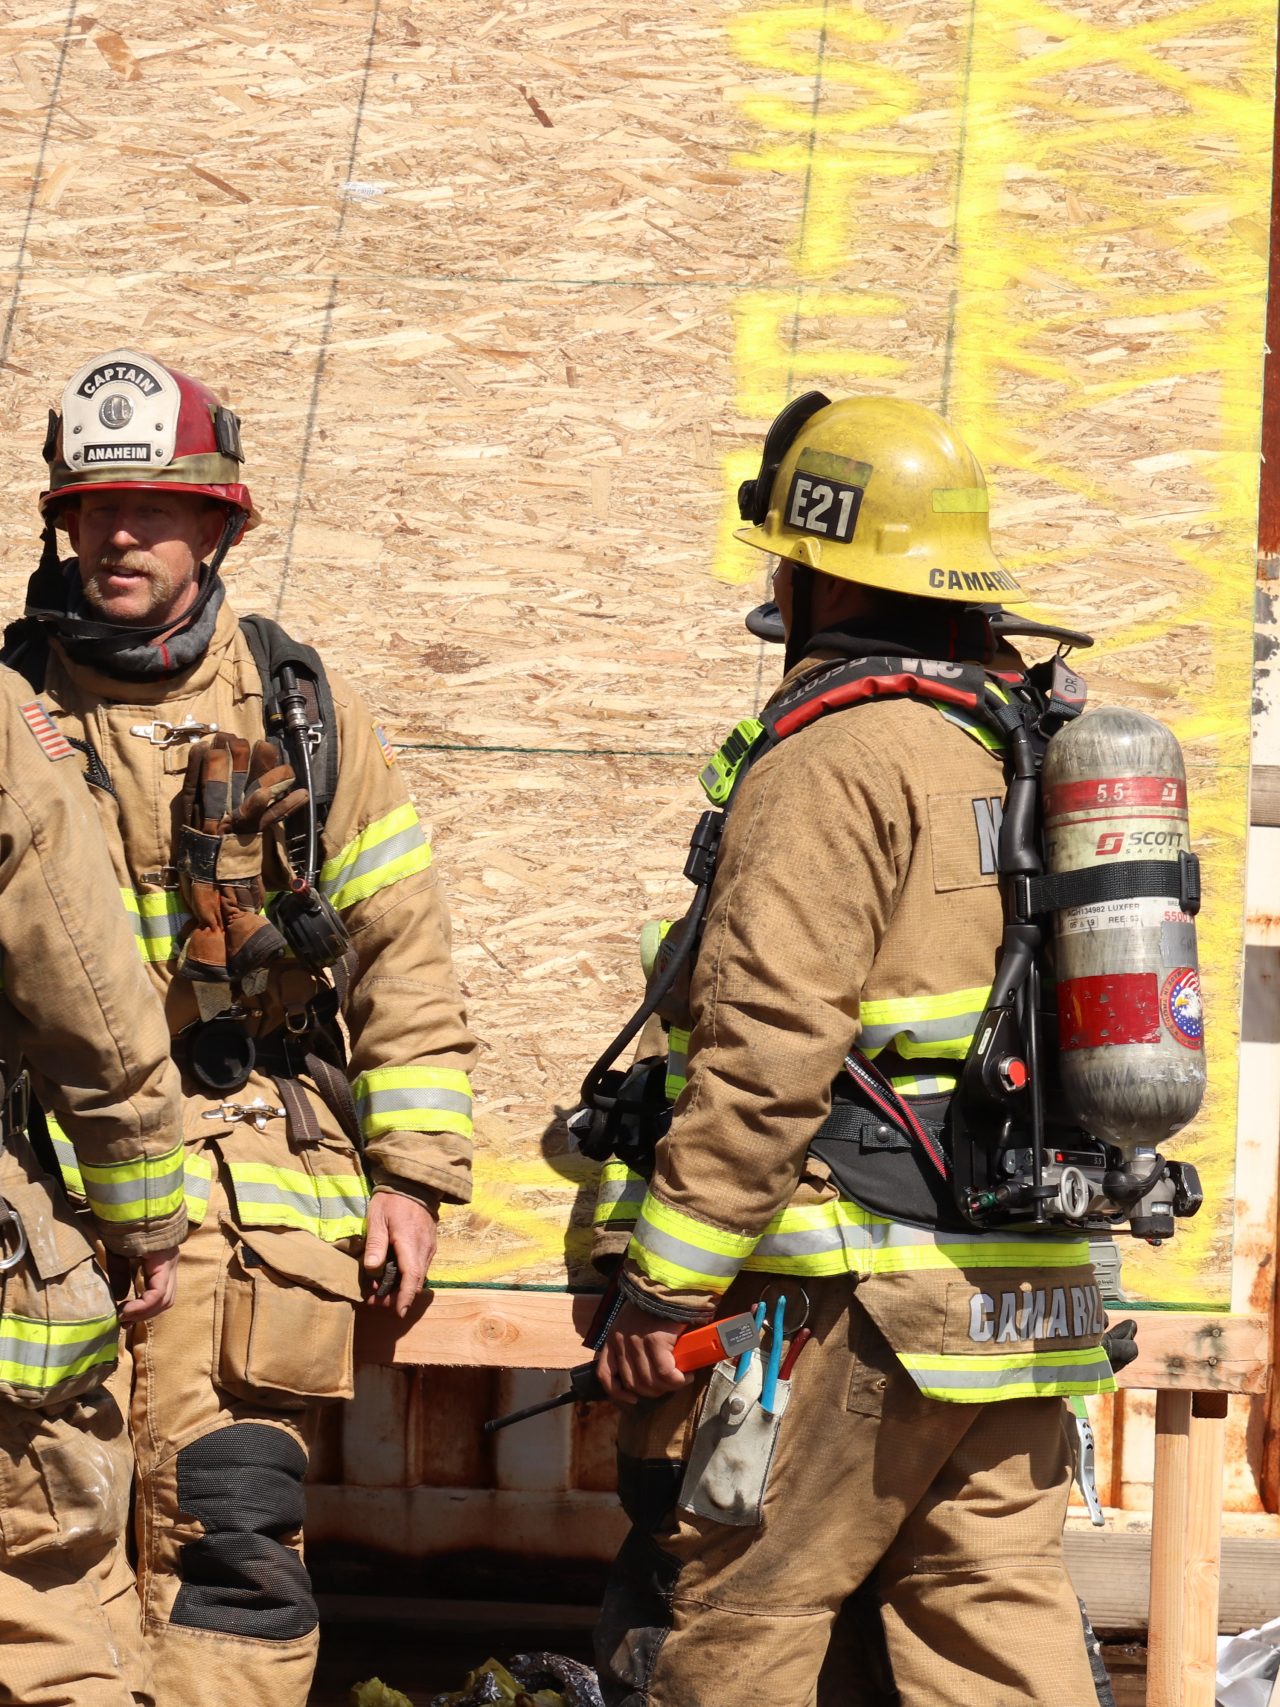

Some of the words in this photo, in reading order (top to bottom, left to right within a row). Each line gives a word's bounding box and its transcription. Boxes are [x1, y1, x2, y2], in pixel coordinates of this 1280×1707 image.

[83, 366, 155, 394] CAPTAIN
[87, 447, 147, 461] ANAHEIM
[789, 479, 855, 537] E21
[1128, 831, 1183, 847] SCOTT
[1108, 903, 1140, 912] LUXFER
